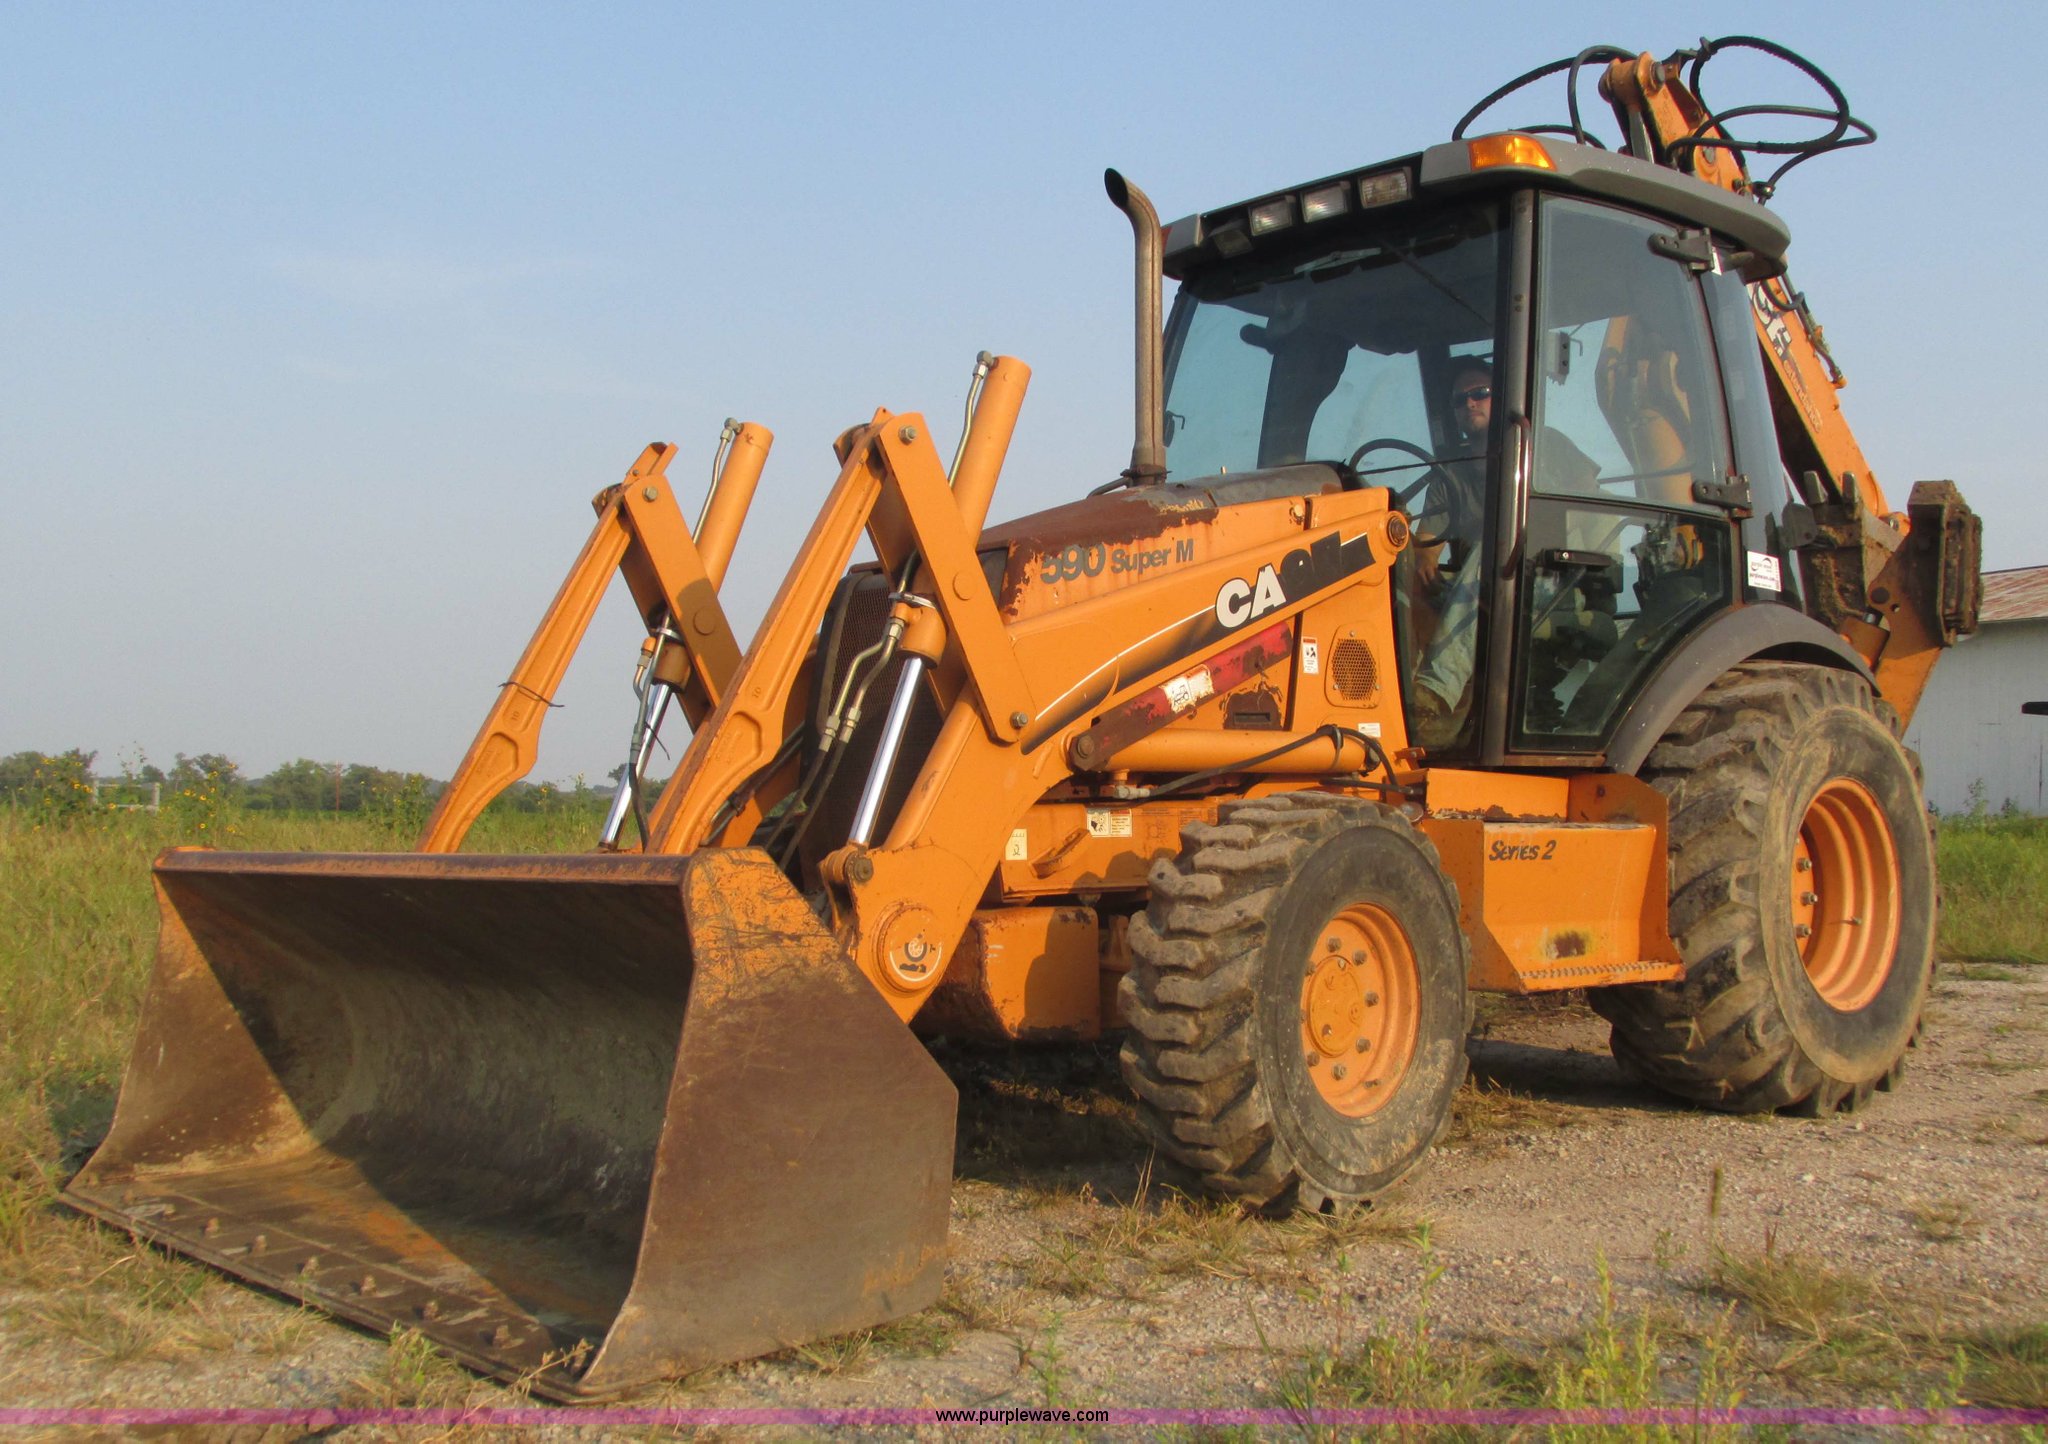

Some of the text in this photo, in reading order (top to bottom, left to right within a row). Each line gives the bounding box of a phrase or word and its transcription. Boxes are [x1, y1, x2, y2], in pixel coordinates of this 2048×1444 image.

[1040, 538, 1194, 584] 590 Super M
[1489, 840, 1557, 861] Series 2
